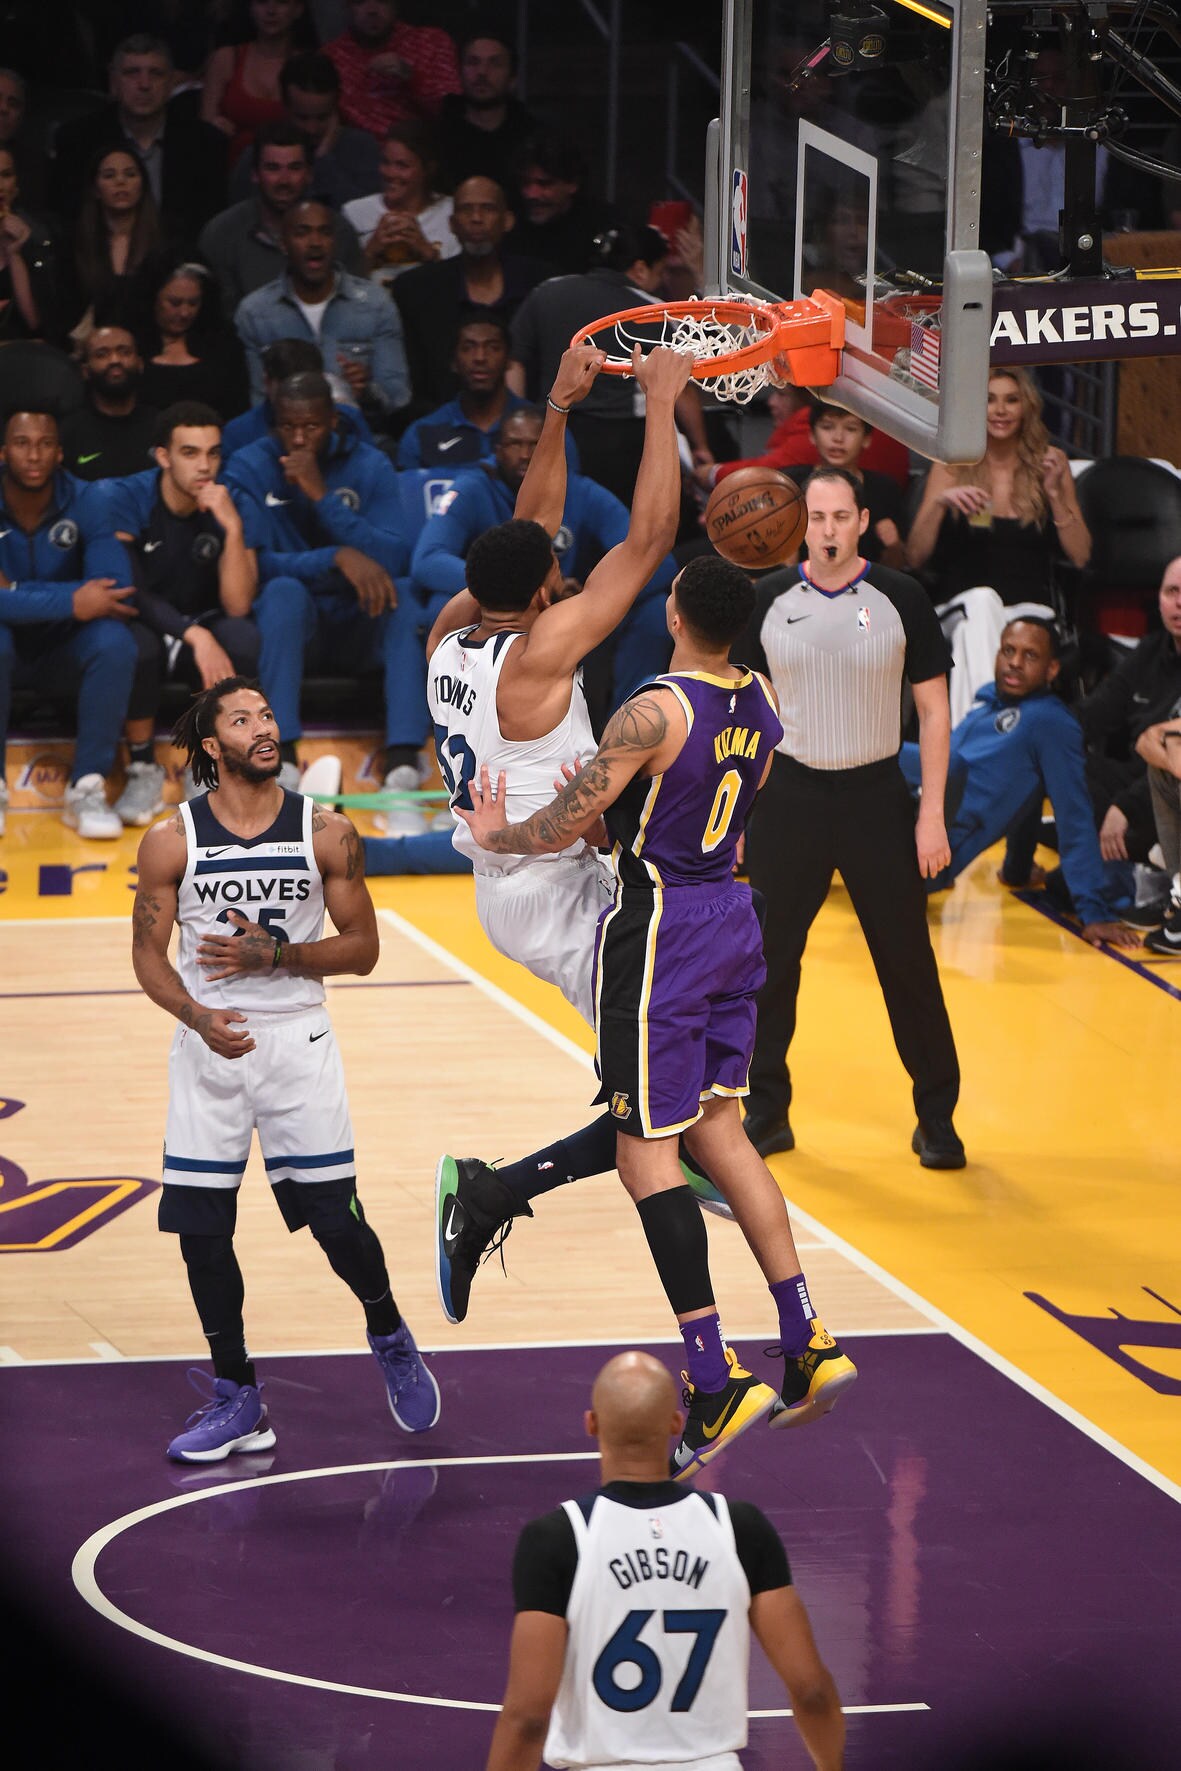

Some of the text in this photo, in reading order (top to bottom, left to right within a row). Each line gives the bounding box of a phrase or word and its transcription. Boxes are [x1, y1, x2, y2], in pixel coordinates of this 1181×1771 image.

[701, 769, 743, 854] 0
[277, 845, 300, 854] fitbit
[193, 878, 311, 905] WOLVES
[609, 1548, 710, 1590] GIBSON
[592, 1609, 728, 1713] 67
